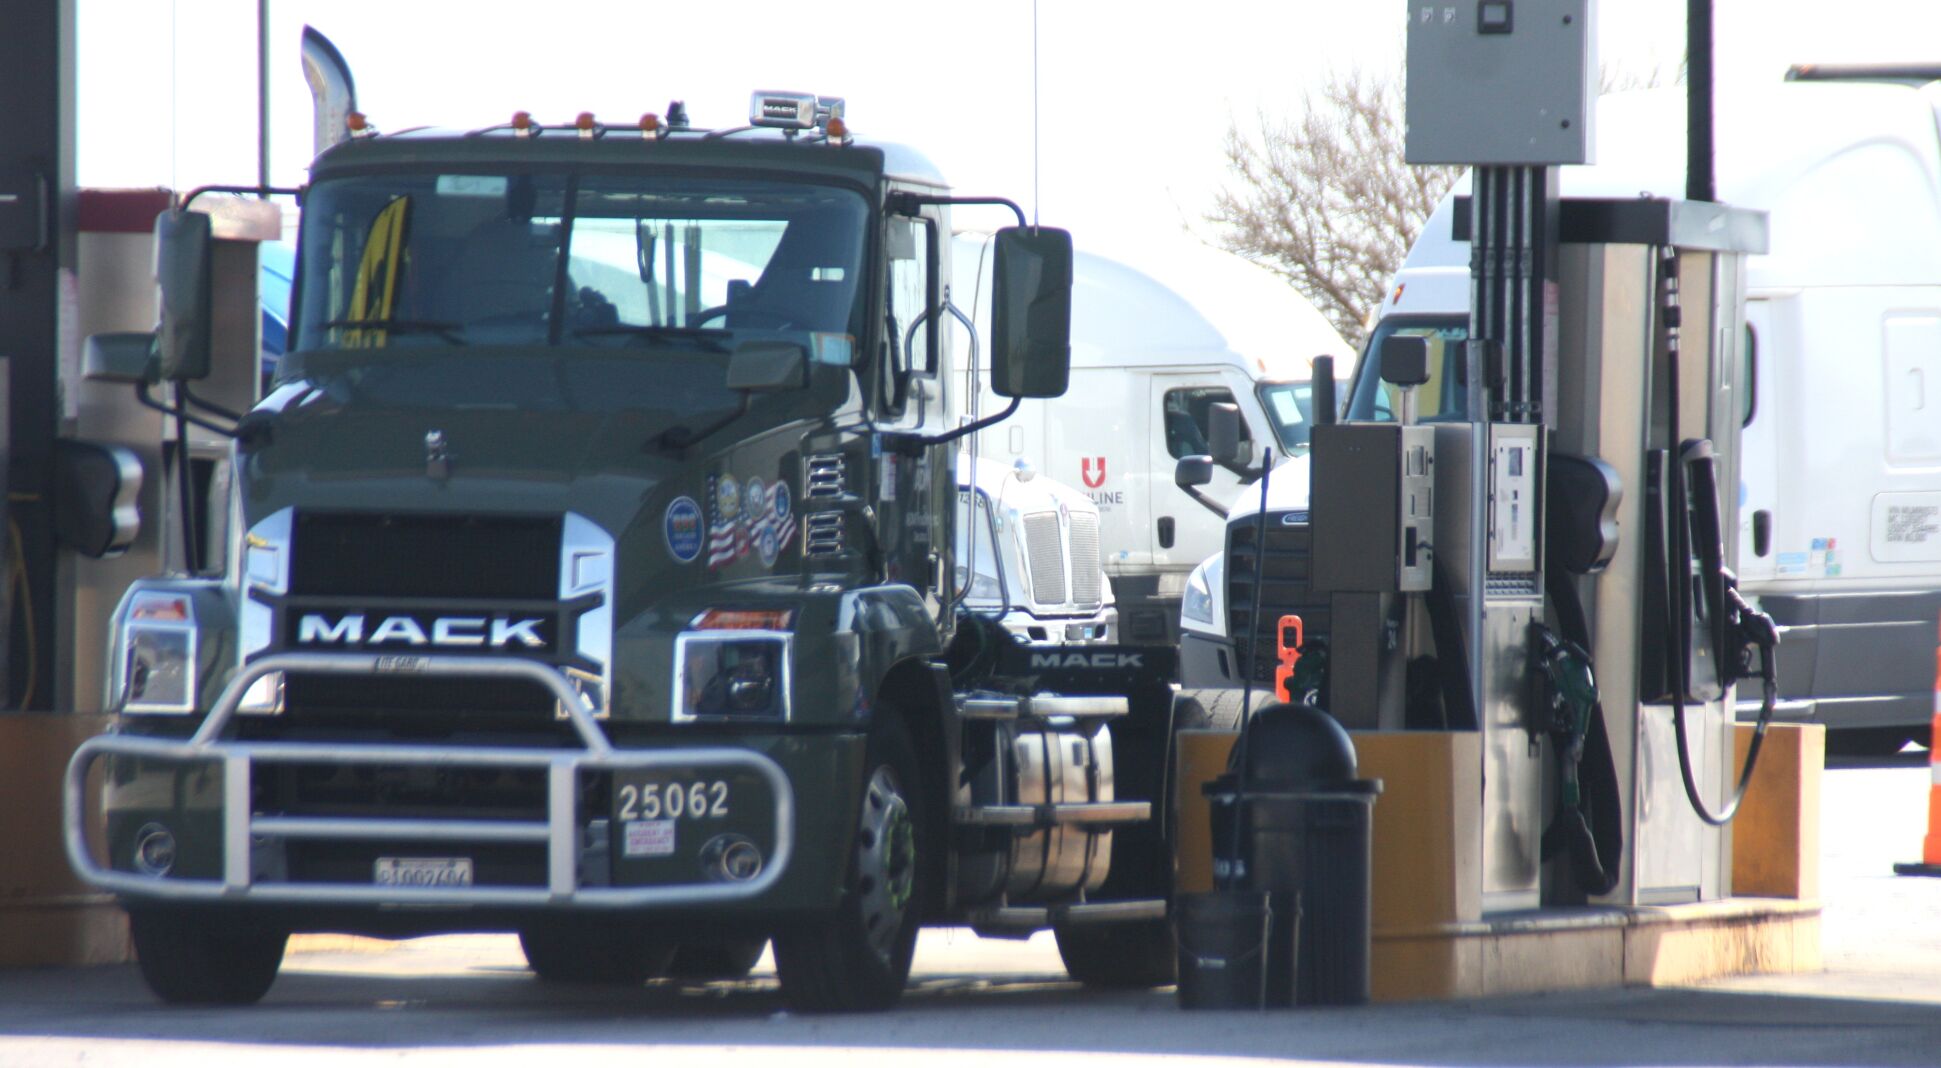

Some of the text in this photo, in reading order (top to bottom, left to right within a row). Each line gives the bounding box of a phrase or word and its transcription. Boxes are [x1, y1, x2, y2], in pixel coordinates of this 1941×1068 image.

[763, 105, 797, 113] MACK
[299, 614, 547, 646] MACK
[1031, 653, 1144, 668] MACK
[619, 781, 729, 820] 25062
